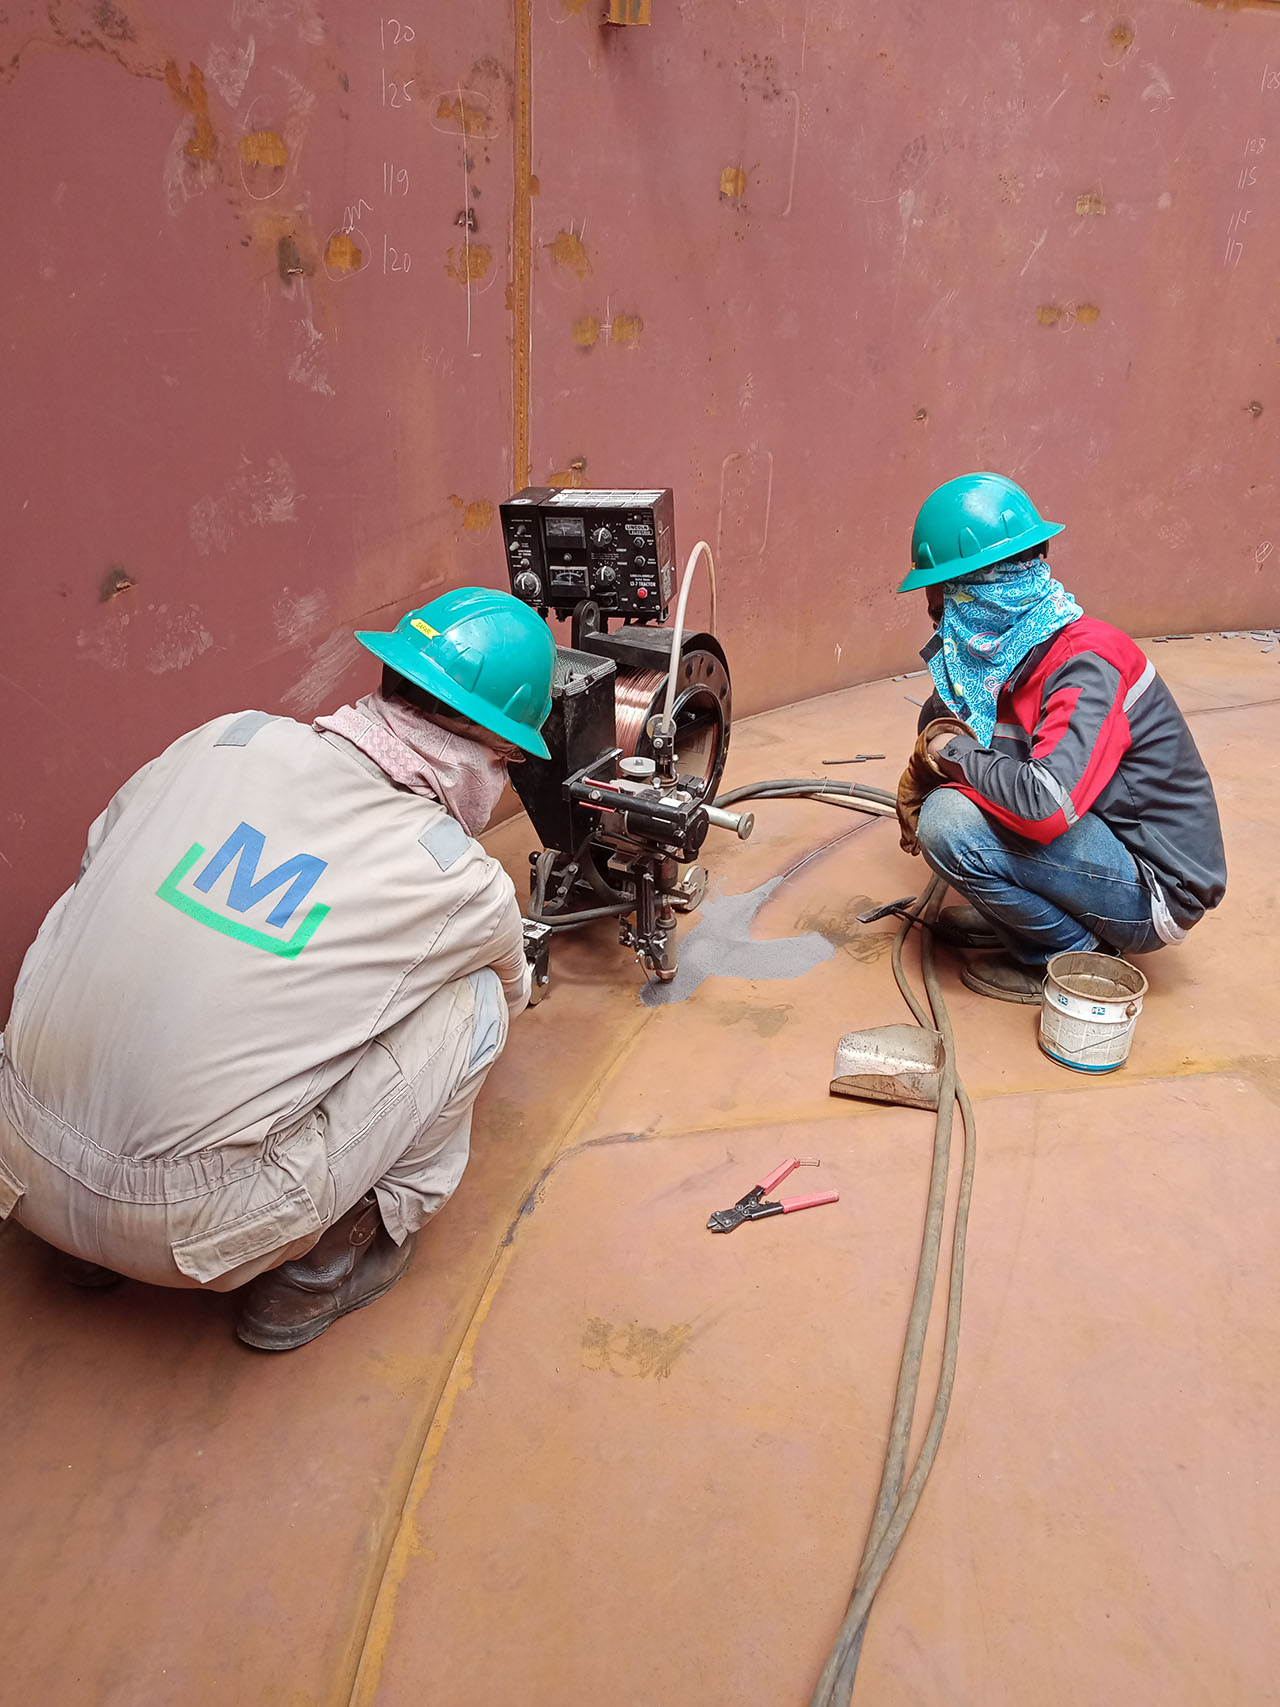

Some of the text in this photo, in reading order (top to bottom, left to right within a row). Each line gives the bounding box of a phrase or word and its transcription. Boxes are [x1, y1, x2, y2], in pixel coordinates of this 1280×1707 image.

[380, 17, 416, 51] 120
[382, 67, 416, 109] 125
[383, 161, 409, 197] 119
[383, 233, 412, 275] 120
